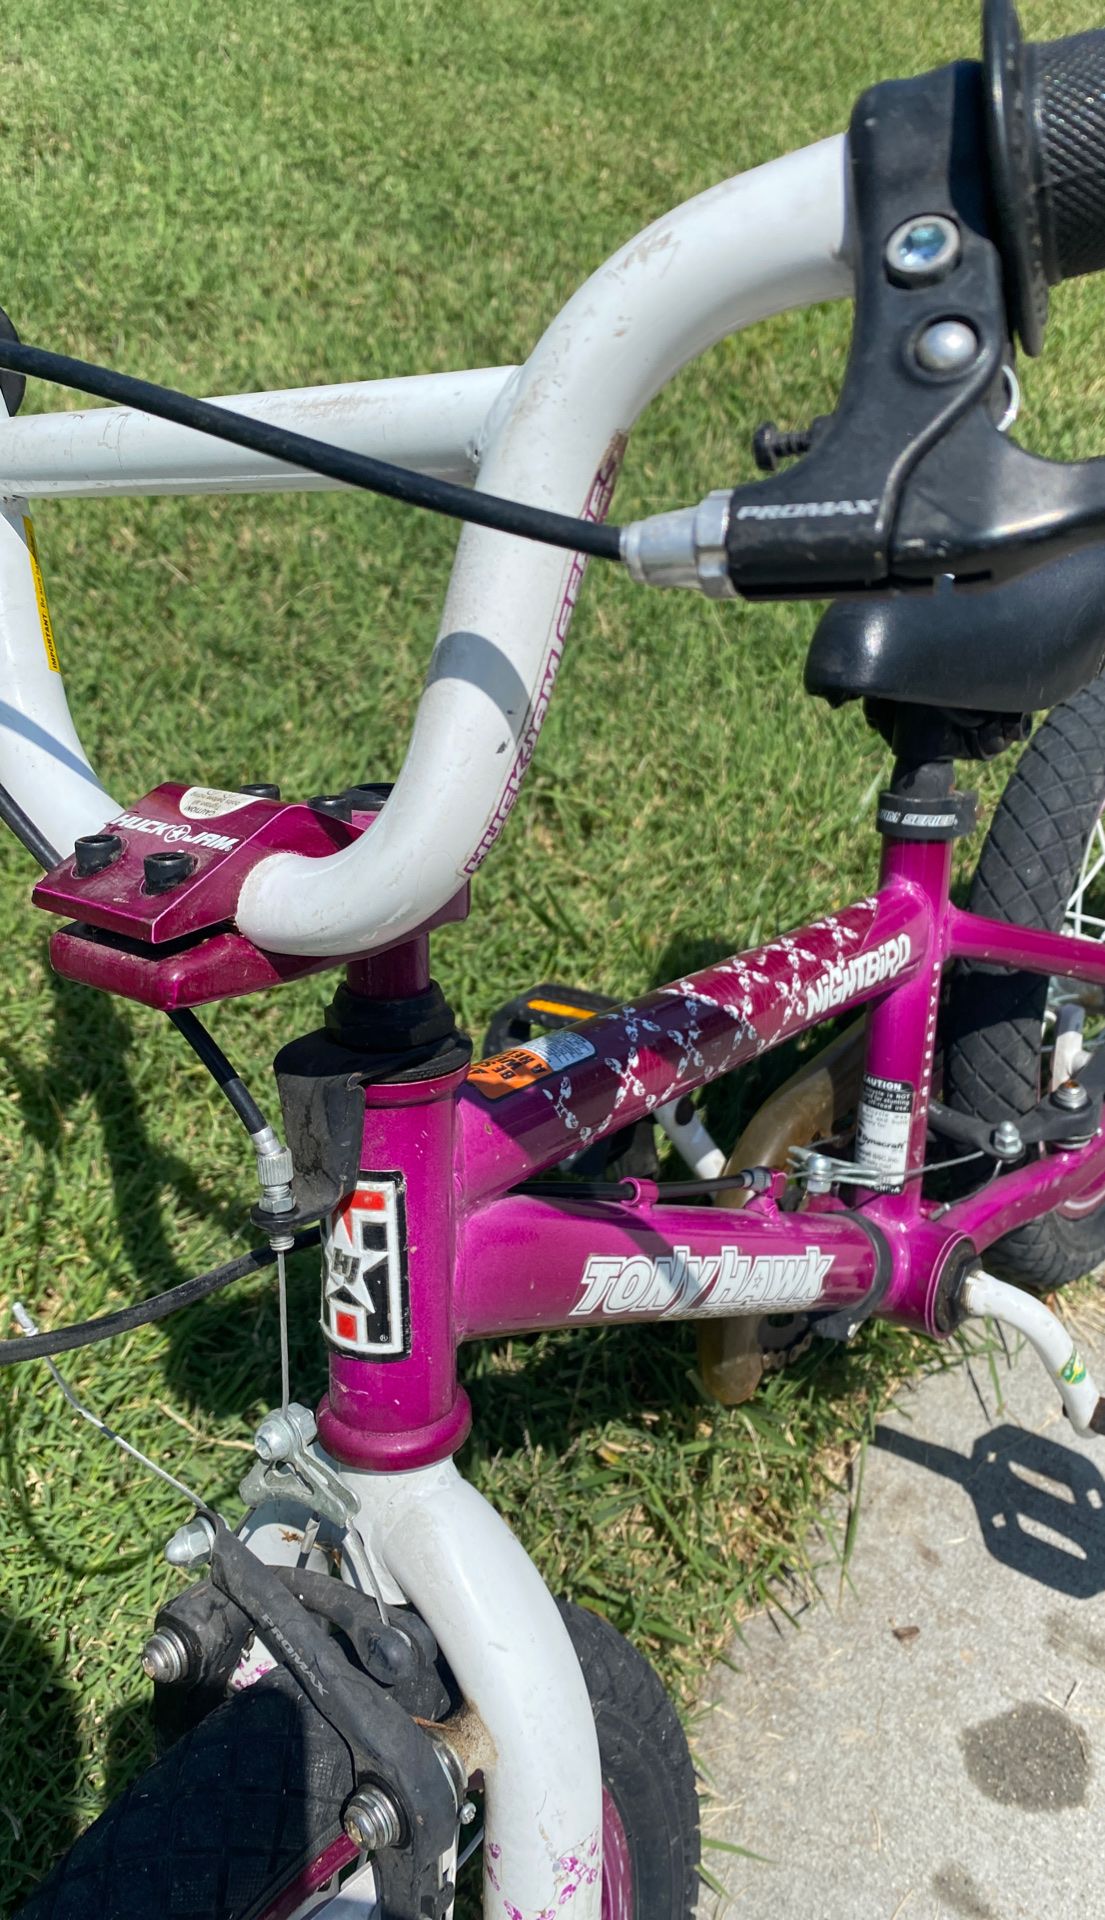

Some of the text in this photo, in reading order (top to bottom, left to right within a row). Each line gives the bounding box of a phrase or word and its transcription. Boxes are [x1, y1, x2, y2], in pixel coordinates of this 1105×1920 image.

[737, 499, 878, 520] PROMAX
[110, 814, 240, 852] HUCK JAM
[262, 1613, 329, 1696] PROMAX
